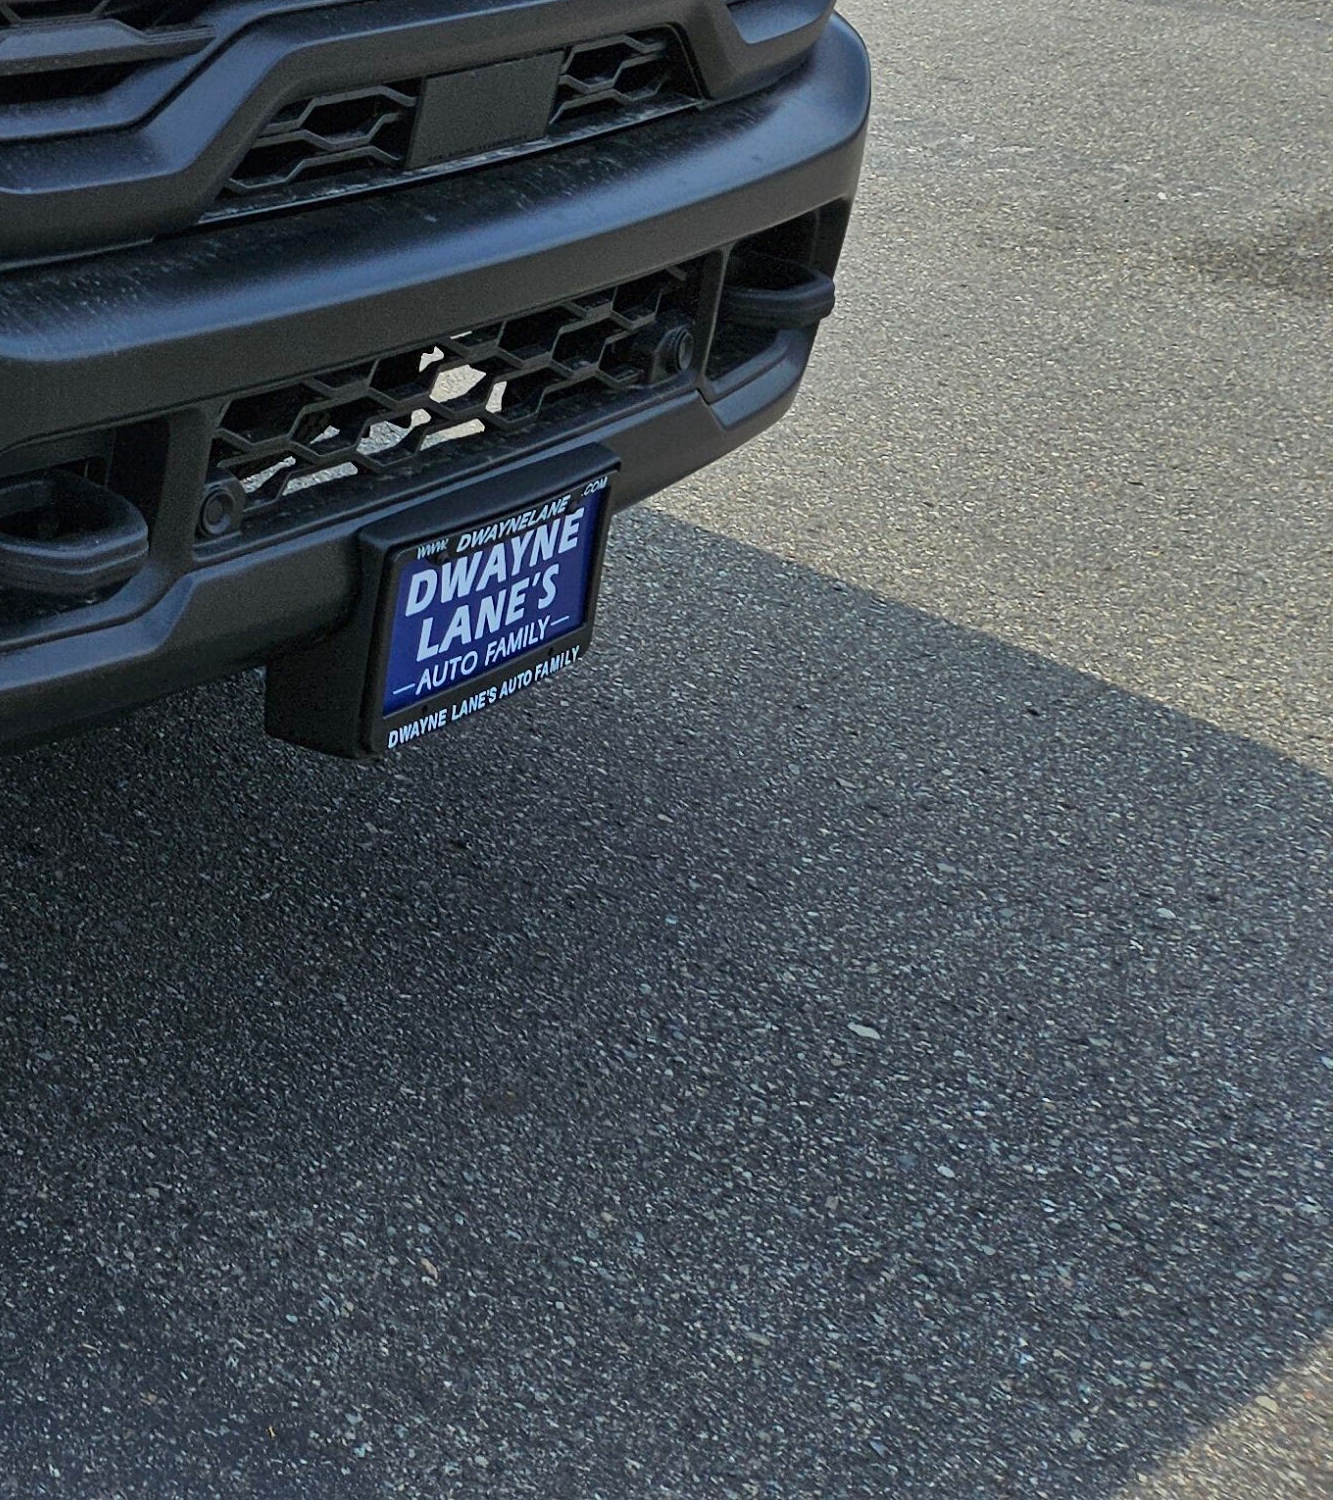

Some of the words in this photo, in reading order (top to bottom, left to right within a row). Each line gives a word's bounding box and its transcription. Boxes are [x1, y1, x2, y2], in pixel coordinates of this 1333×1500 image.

[405, 507, 584, 617] DWAYNE
[456, 495, 570, 552] DWAYNELANE
[415, 653, 478, 695] AUTO
[484, 615, 551, 667] FAMILY
[416, 563, 559, 663] LANE'S
[388, 712, 447, 749] DWAYNE
[451, 687, 497, 721] LANE'S
[499, 670, 533, 699] AUTO
[534, 645, 580, 681] FAMILY
